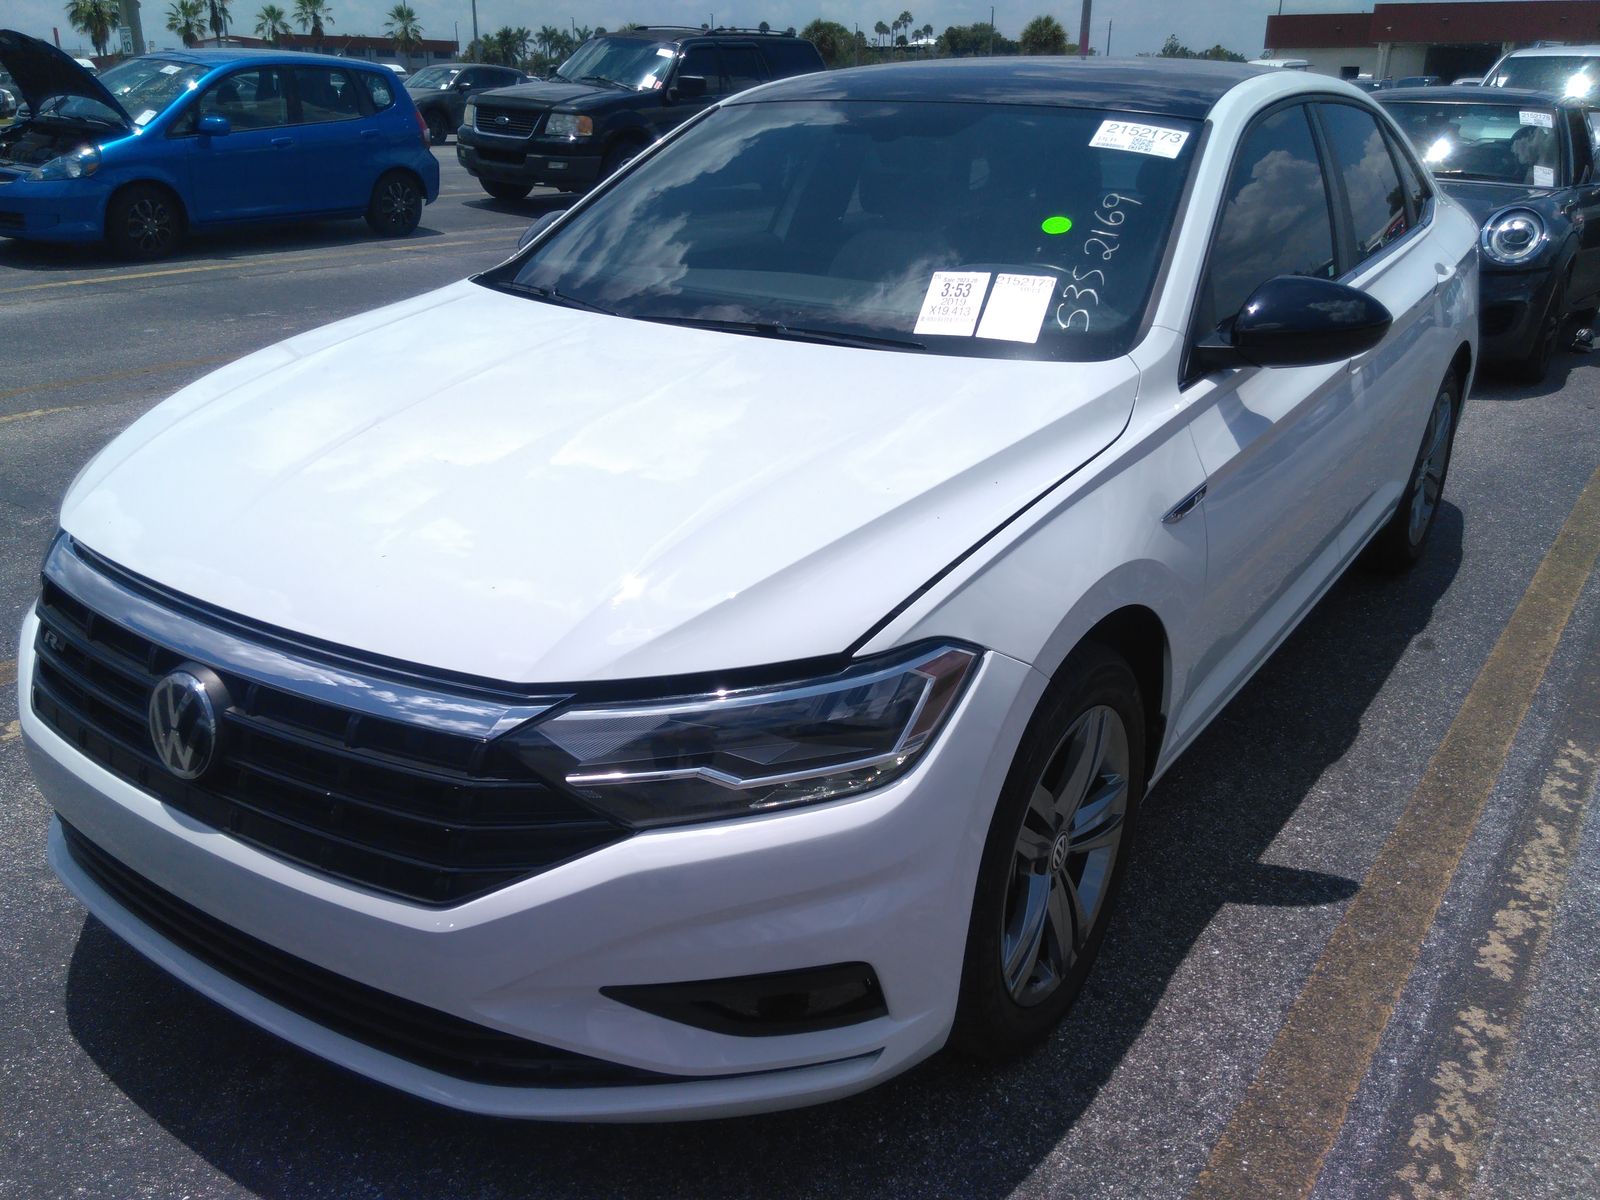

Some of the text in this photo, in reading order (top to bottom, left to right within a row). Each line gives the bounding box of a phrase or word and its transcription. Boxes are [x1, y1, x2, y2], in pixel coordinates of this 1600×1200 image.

[1106, 123, 1182, 143] 2152173
[995, 275, 1055, 288] 2152173
[941, 282, 972, 297] 3:53
[940, 297, 967, 305] 2019
